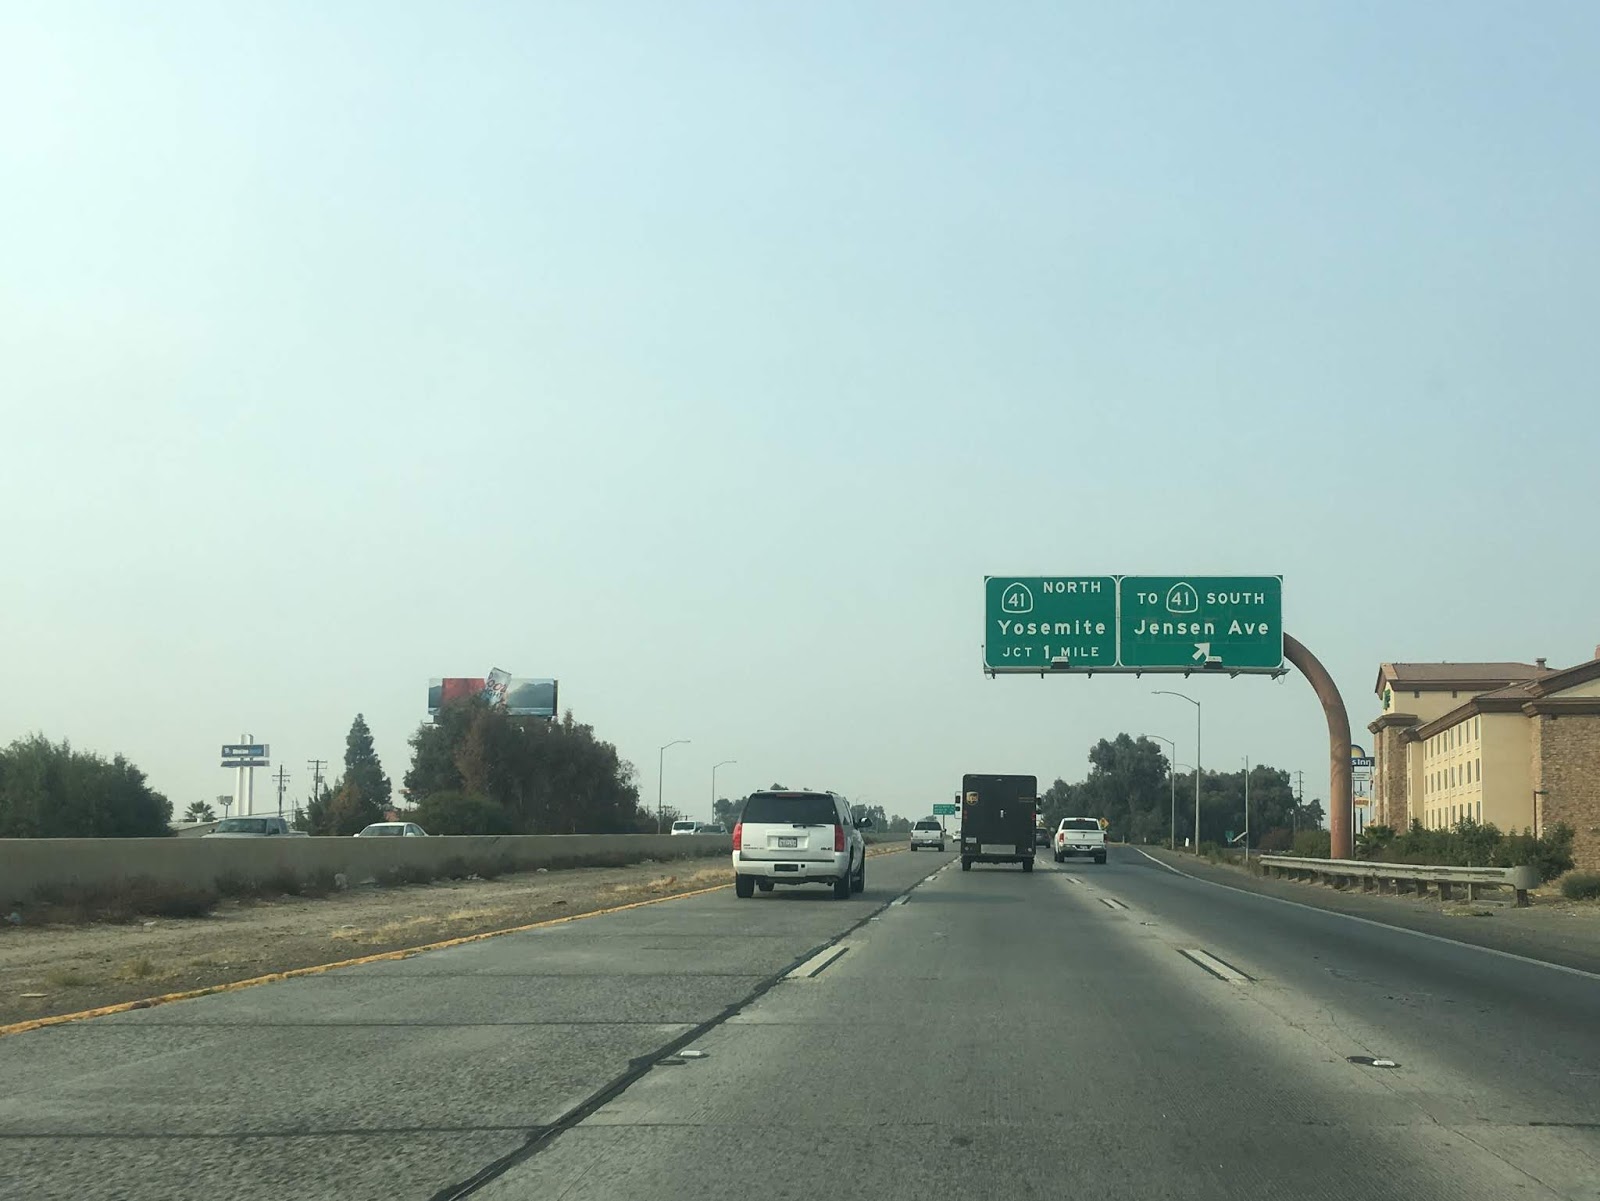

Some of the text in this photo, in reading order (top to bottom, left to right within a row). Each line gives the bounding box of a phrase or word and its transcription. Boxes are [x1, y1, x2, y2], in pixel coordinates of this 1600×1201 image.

[1043, 581, 1101, 593] NORTH
[1008, 593, 1025, 607] 41
[1137, 592, 1265, 606] TO 41 SOUTH
[997, 619, 1106, 635] Yosemite
[1134, 619, 1269, 635] Jensen Ave
[1002, 644, 1100, 659] JCT 1 MILE
